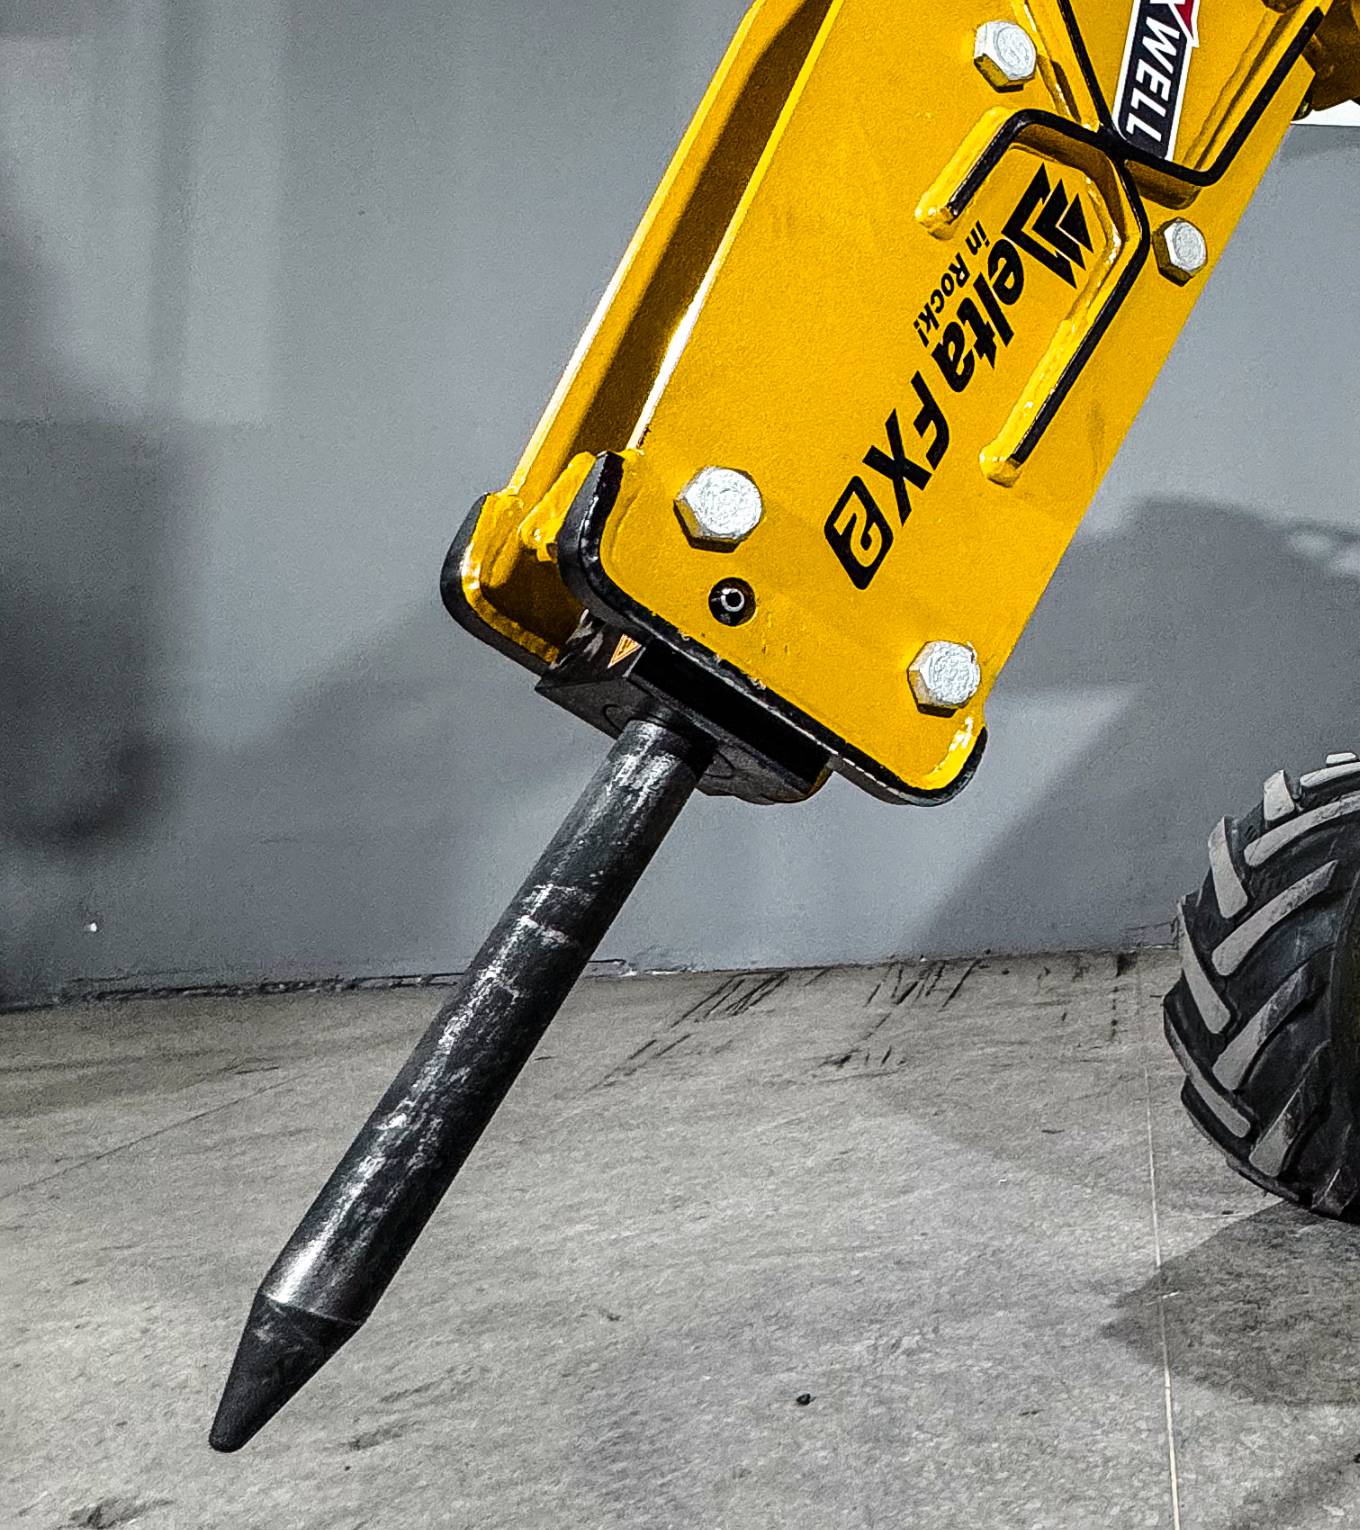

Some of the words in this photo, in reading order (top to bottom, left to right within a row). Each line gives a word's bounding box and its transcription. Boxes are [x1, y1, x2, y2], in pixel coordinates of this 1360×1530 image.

[1126, 0, 1184, 142] WELL
[964, 220, 987, 256] in
[914, 252, 971, 348] Rock!
